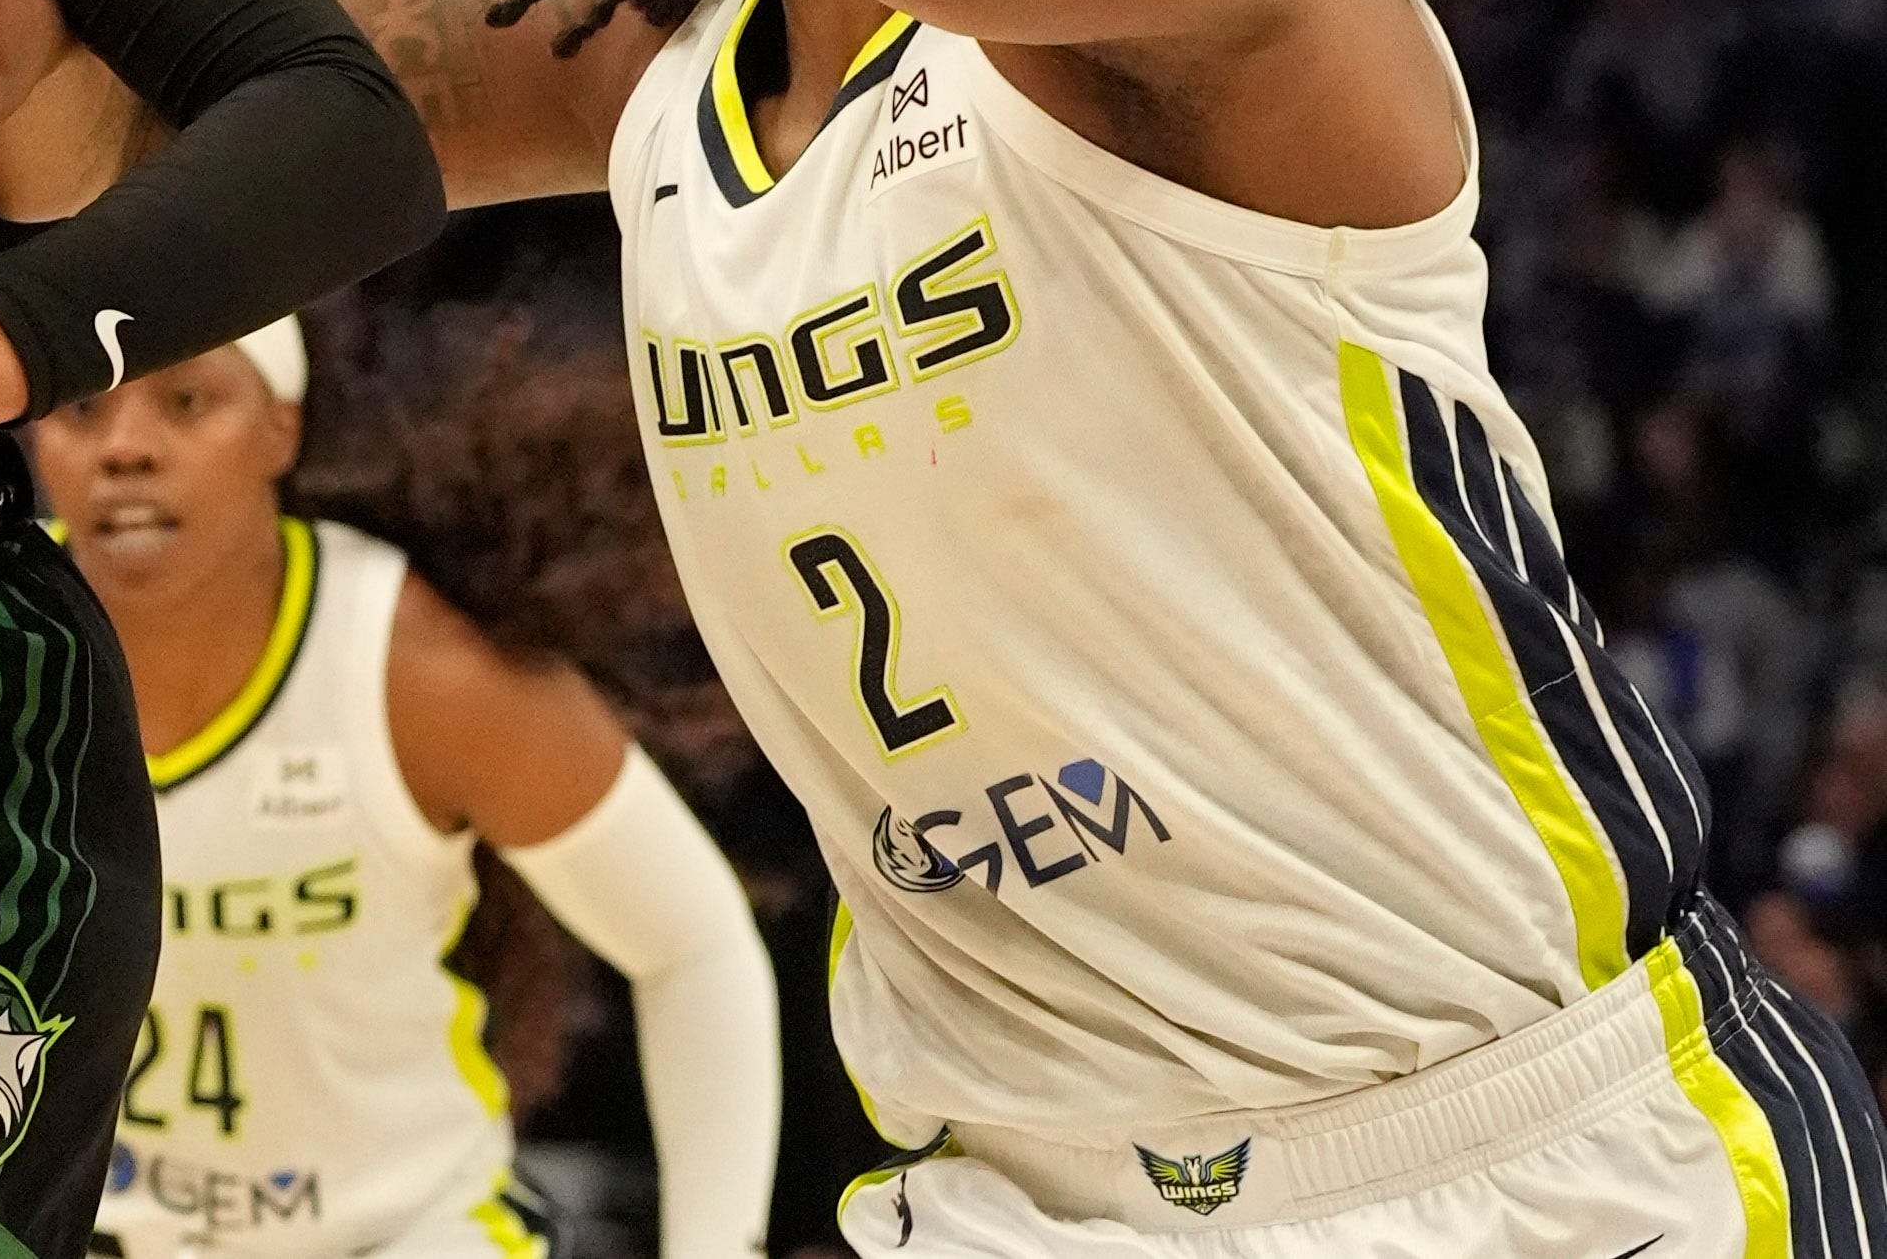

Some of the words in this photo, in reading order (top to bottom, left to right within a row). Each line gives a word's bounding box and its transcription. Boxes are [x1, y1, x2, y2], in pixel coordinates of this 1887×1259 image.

[870, 116, 969, 190] Albert
[783, 524, 968, 765] 2
[915, 760, 1173, 898] GEM
[121, 1003, 245, 1138] 24
[149, 1155, 322, 1230] GEM
[1160, 1179, 1237, 1200] WINGS
